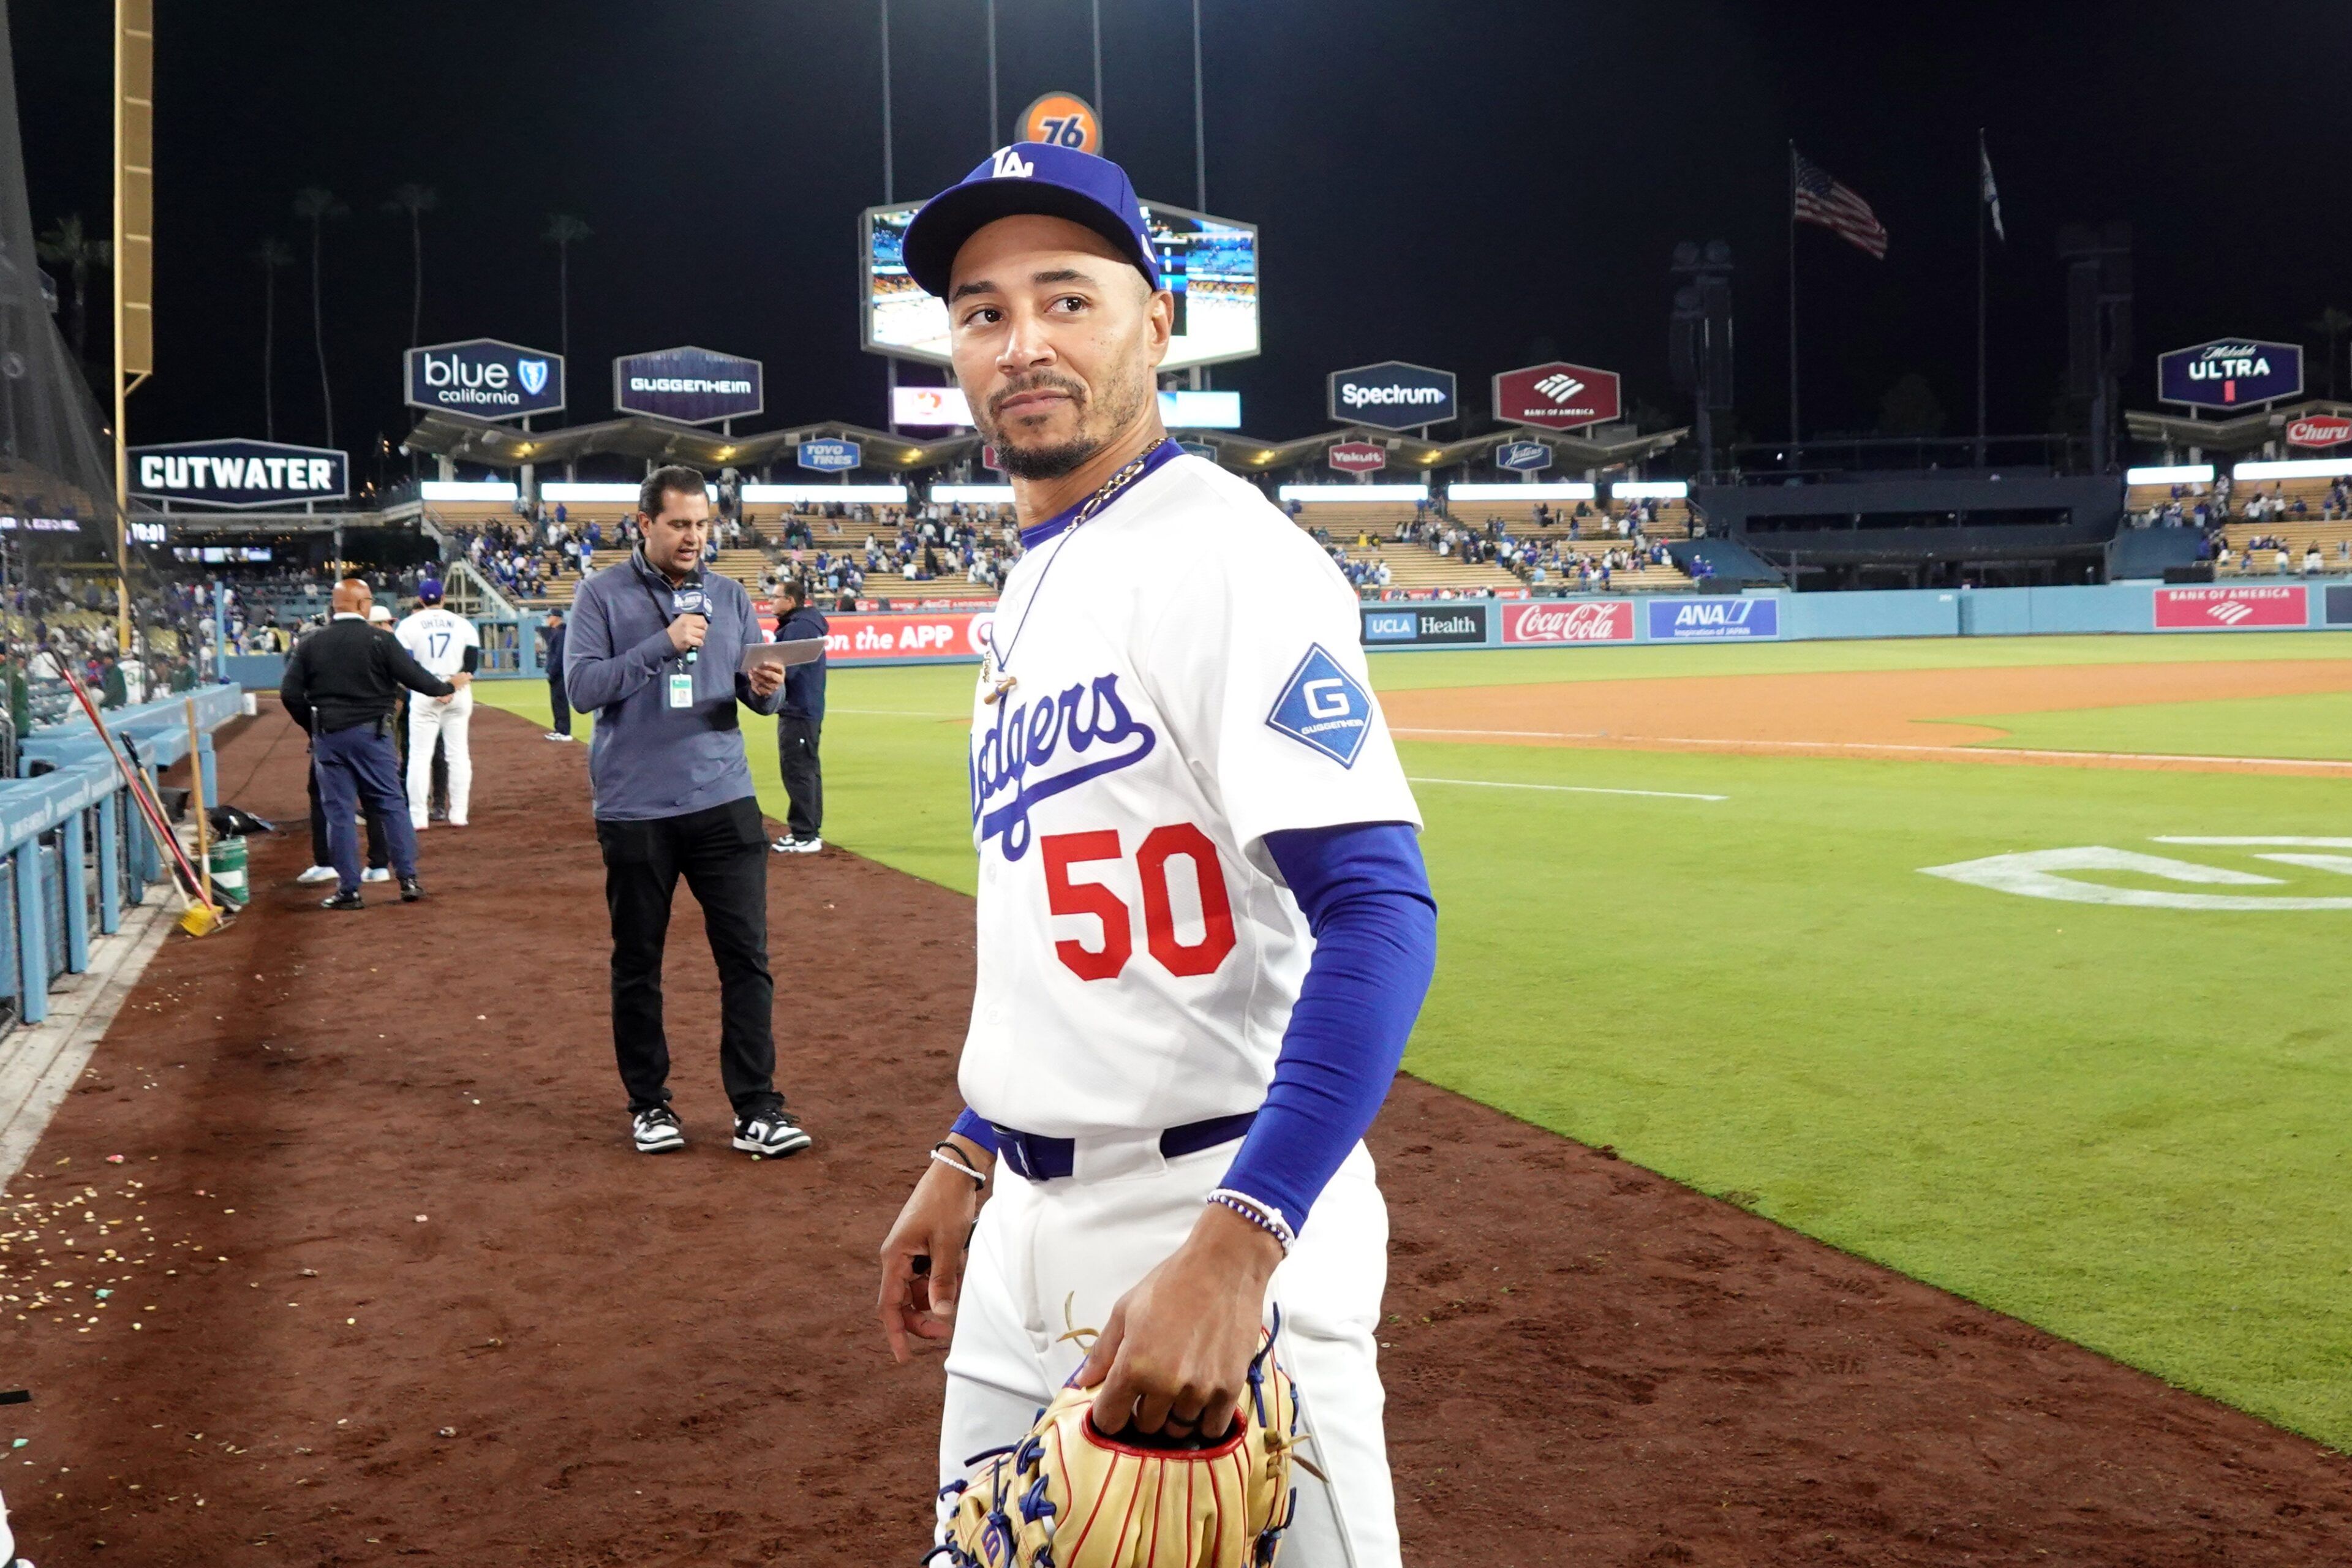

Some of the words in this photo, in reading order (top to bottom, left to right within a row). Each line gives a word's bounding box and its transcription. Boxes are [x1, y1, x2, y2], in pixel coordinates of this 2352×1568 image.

[1040, 114, 1085, 148] 76
[992, 146, 1034, 178] LA
[424, 353, 509, 389] blue
[2188, 358, 2271, 380] ULTRA
[438, 388, 519, 405] california
[630, 377, 752, 394] GUGGENHEIM
[1342, 383, 1441, 409] Spectrum
[2291, 423, 2349, 440] Churu
[807, 445, 843, 454] TOYO
[813, 455, 853, 465] TIRES
[1333, 452, 1382, 462] Yakult
[140, 456, 333, 490] CUTWATER
[2169, 591, 2206, 601] BANK
[2209, 590, 2225, 600] OF
[2228, 589, 2290, 599] AMERICA
[1373, 619, 1411, 633] UCLA
[1421, 616, 1476, 634] Health
[1515, 604, 1619, 640] Coca-Cola
[1675, 605, 1725, 625] ANA
[428, 633, 451, 658] 17
[856, 625, 894, 650] the
[899, 625, 954, 649] APP
[1303, 677, 1351, 719] G
[1301, 718, 1365, 735] GUGGENHEIM
[1040, 822, 1237, 982] 50
